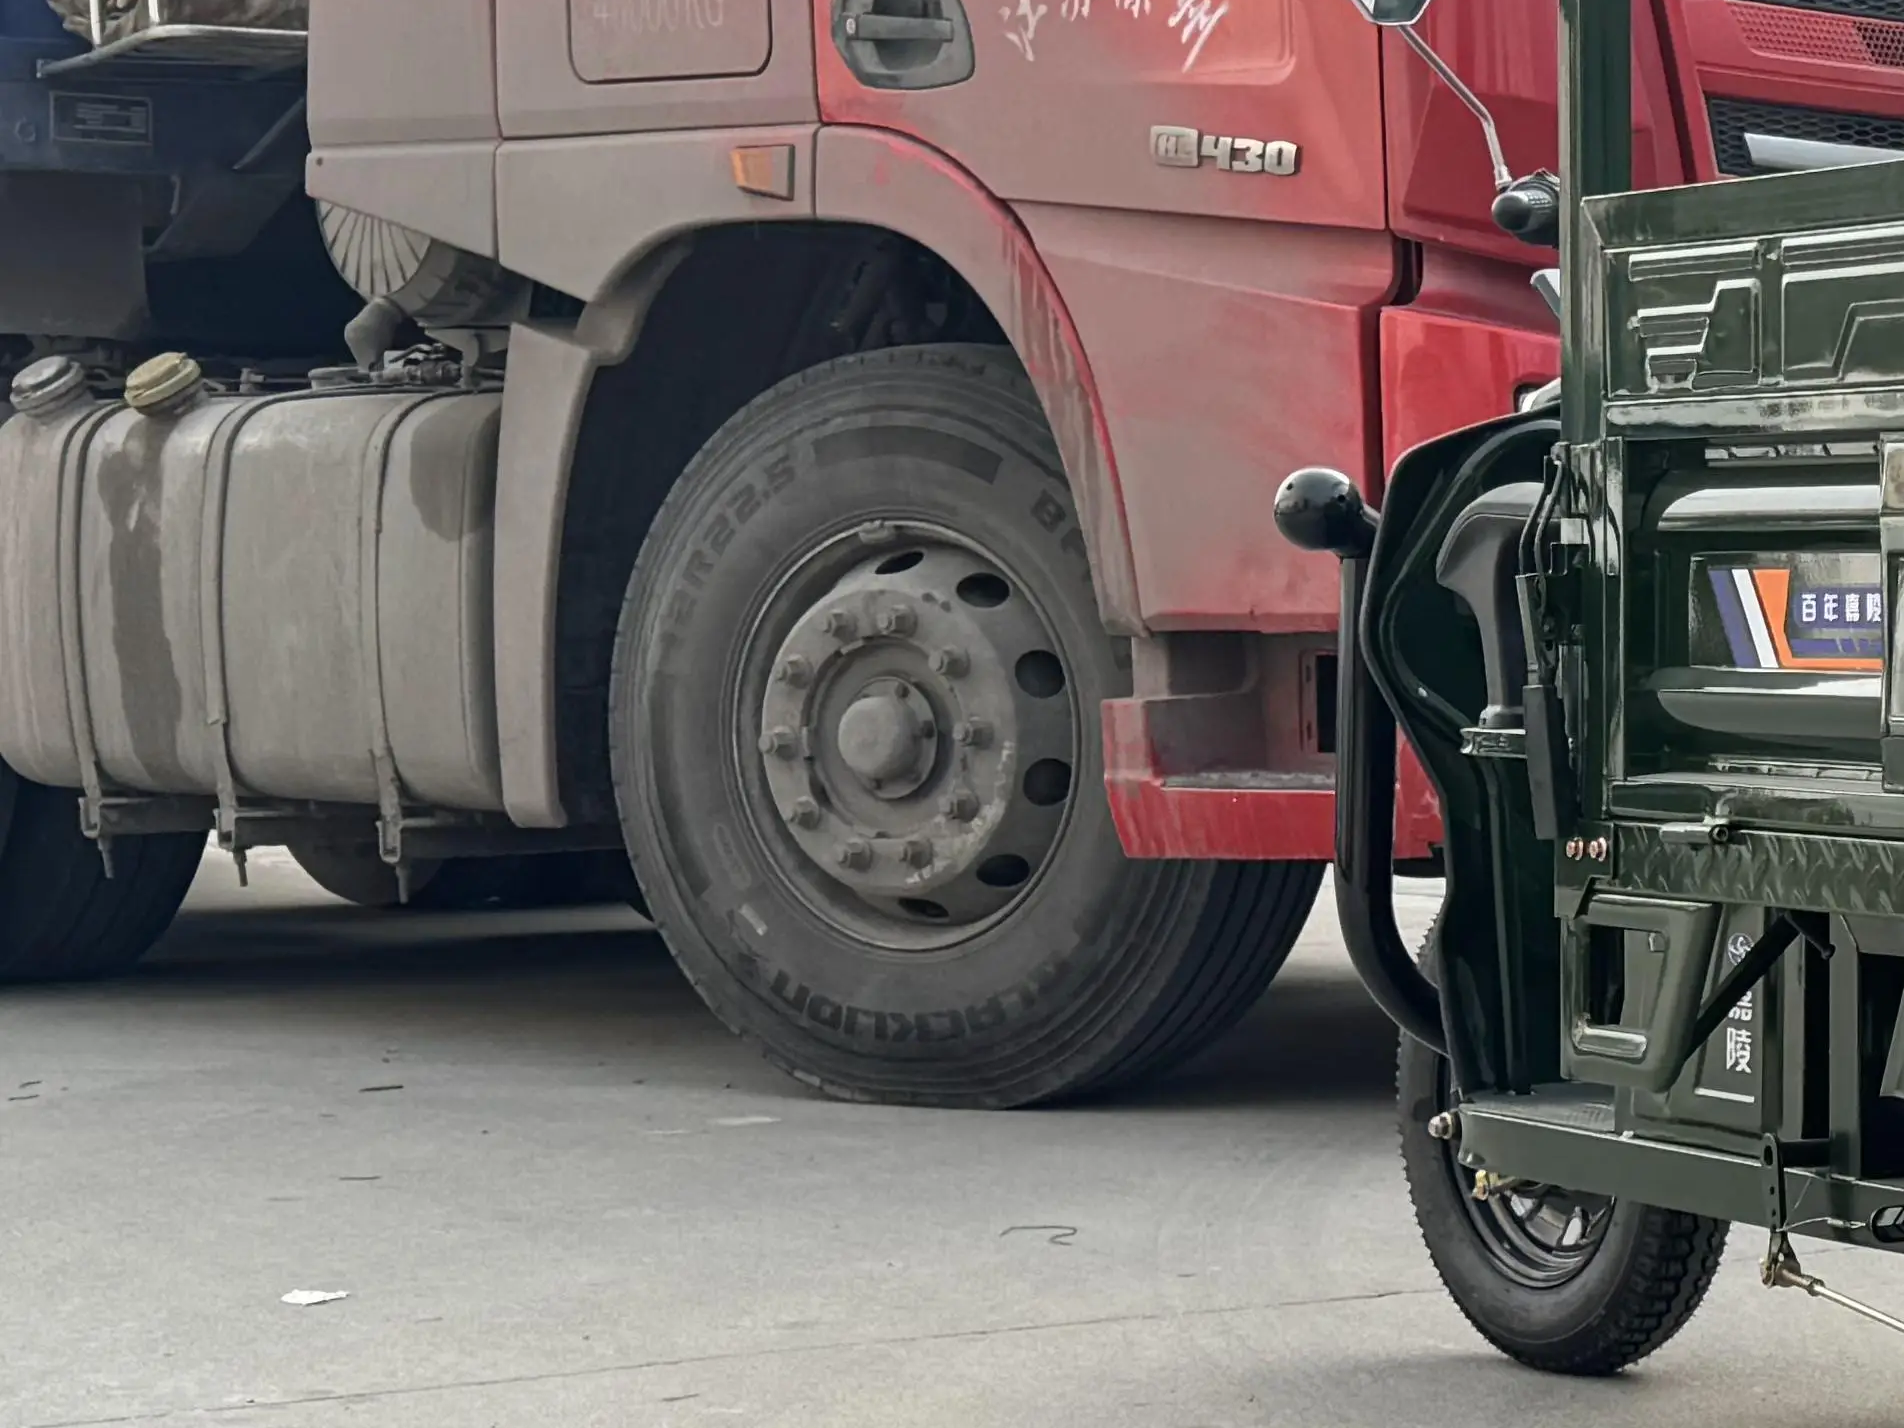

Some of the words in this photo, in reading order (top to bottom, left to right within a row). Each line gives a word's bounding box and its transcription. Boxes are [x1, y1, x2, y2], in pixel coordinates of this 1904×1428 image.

[1199, 134, 1300, 176] 430
[1801, 592, 1882, 623] 百年嘉陵
